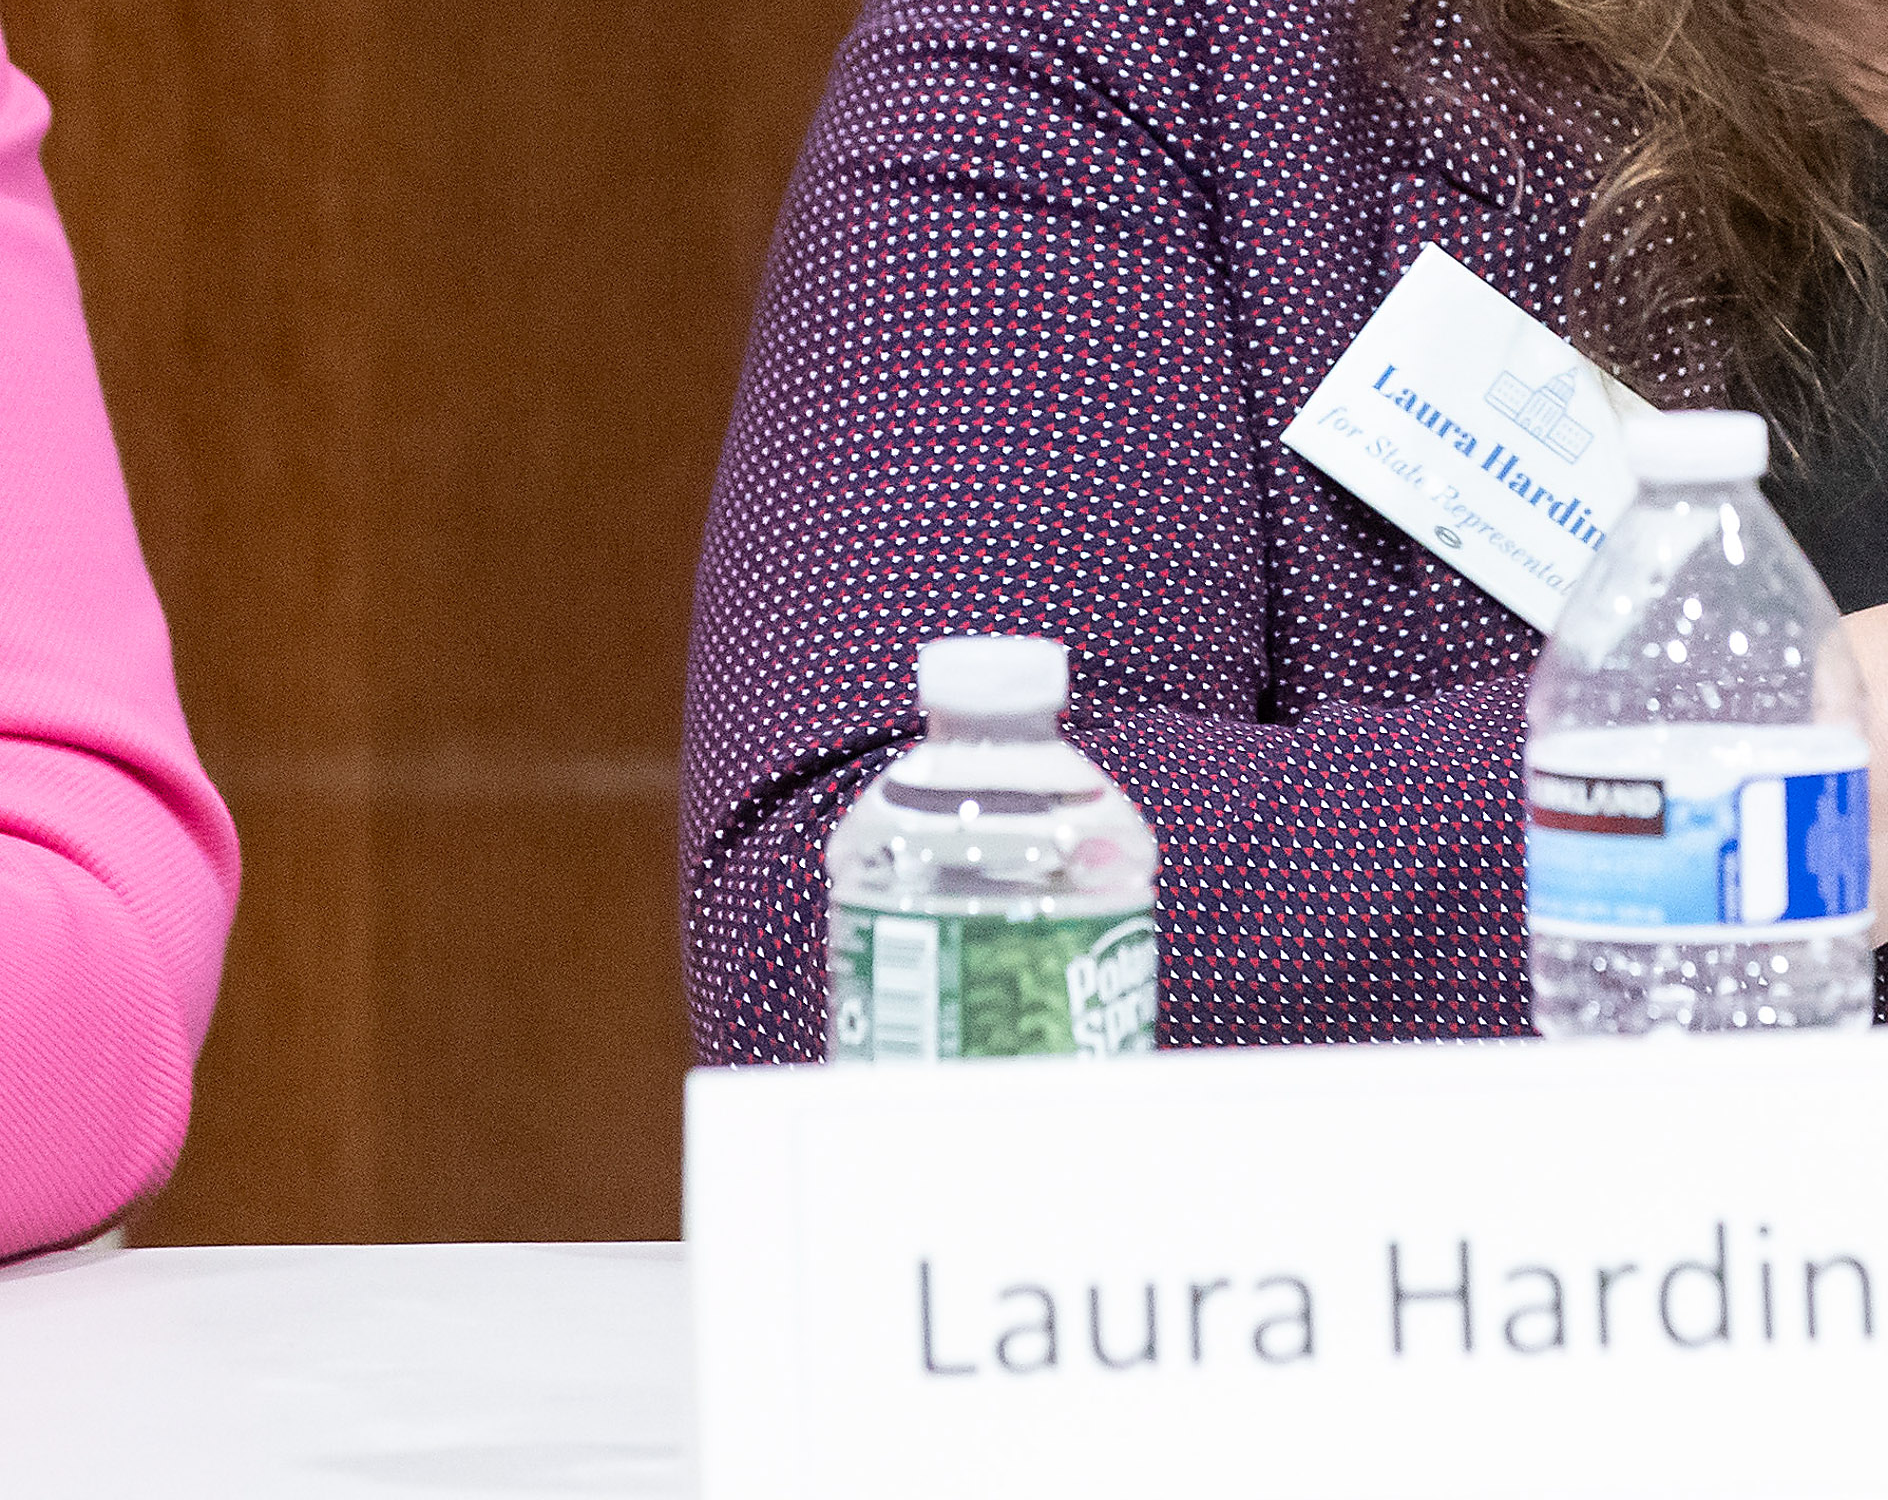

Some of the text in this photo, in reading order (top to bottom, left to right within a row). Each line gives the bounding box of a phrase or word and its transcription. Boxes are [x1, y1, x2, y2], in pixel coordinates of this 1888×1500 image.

[1317, 405, 1364, 439] for
[1373, 364, 1608, 553] Laura Hardin
[918, 1254, 1317, 1376] Laura
